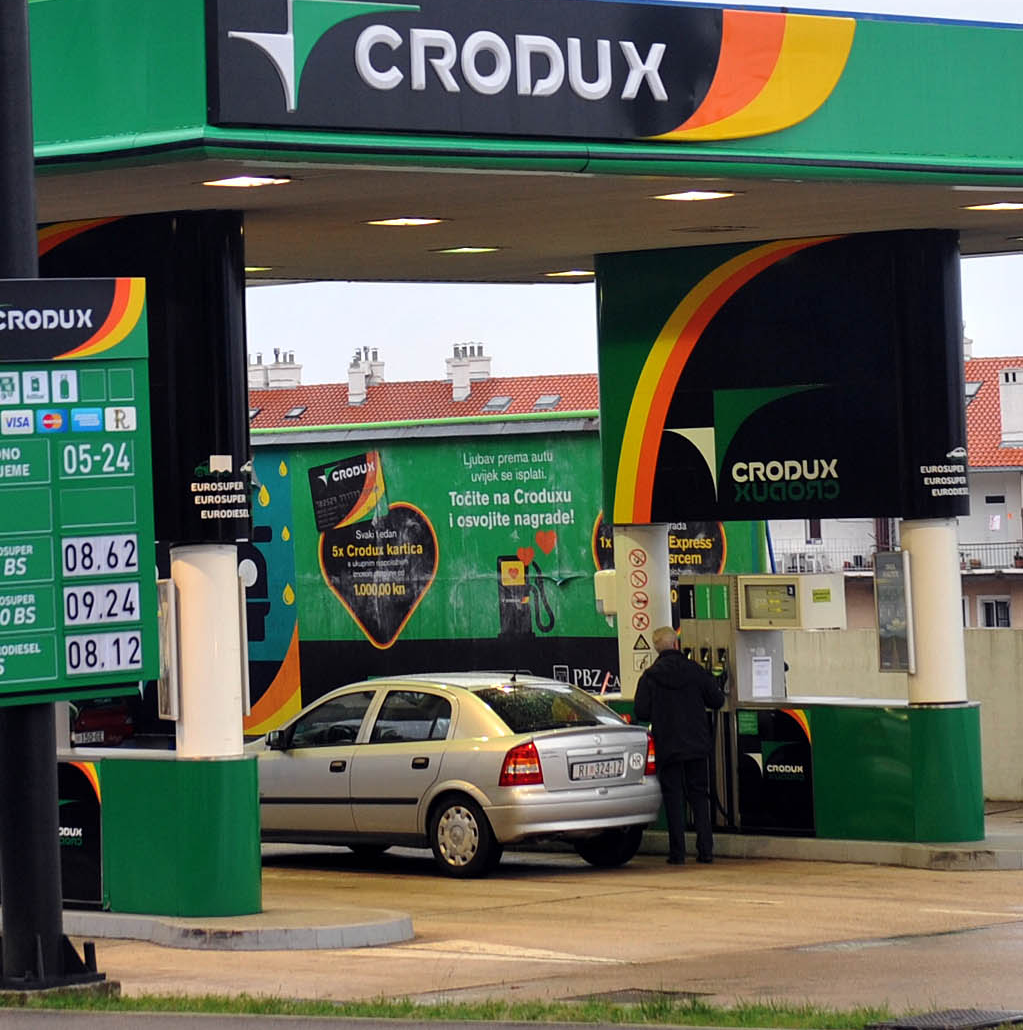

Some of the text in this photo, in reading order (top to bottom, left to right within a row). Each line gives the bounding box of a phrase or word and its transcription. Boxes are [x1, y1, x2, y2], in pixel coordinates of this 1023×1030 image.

[355, 24, 670, 102] CRODUX
[5, 417, 30, 428] VISA
[63, 442, 130, 474] 05-24
[463, 450, 553, 469] Ljubav prema autu
[332, 461, 375, 482] CRODUX
[471, 467, 547, 485] uvijek se isplati.
[732, 459, 839, 483] CRODUX
[190, 481, 244, 492] EUROSUPER
[194, 494, 247, 505] EUROSUPER
[448, 488, 572, 506] Točite na Croduxu
[449, 508, 575, 530] i osvojite nagrade!
[332, 542, 423, 558] 5x Crodux kartica
[599, 535, 712, 551] 1x Express
[4, 557, 27, 576] BS
[668, 554, 702, 565] srcem
[392, 582, 406, 595] kn
[14, 607, 37, 625] BS
[574, 668, 602, 687] PBZ
[632, 754, 642, 770] HR
[767, 764, 804, 774] CRODUX
